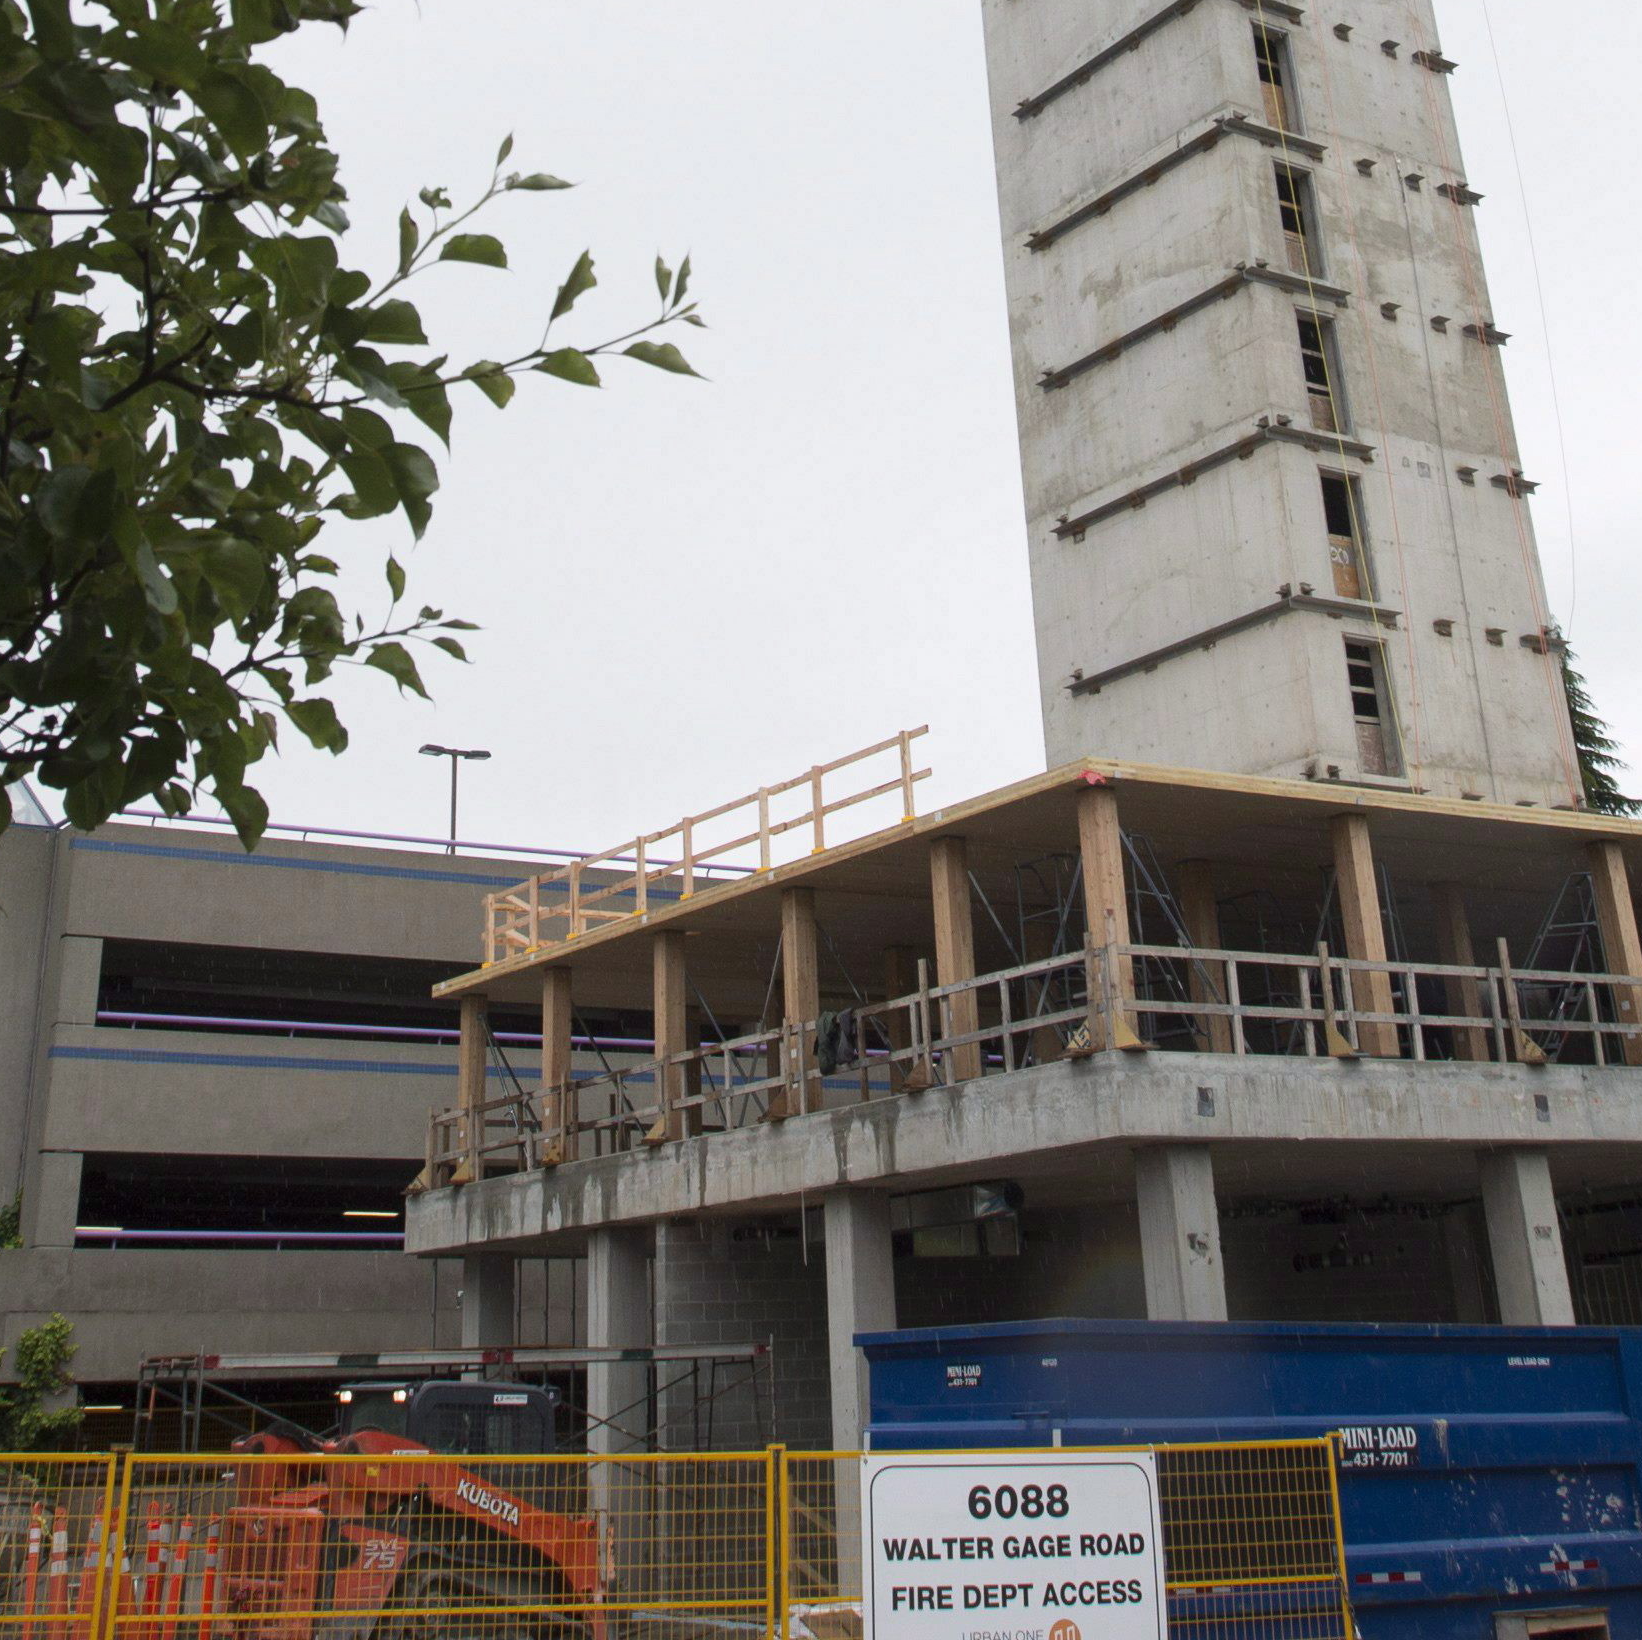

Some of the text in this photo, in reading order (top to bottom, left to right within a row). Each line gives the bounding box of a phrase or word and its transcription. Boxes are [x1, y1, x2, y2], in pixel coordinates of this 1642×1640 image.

[1338, 1426, 1417, 1449] MINI-LOAD
[1354, 1452, 1408, 1467] 431-7701
[456, 1478, 519, 1526] KUBOTA
[967, 1484, 1070, 1520] 6088
[363, 1551, 395, 1569] 75
[883, 1532, 1145, 1561] WALTER GAGE ROAD
[891, 1579, 1143, 1611] FIRE DEPT ACCESS
